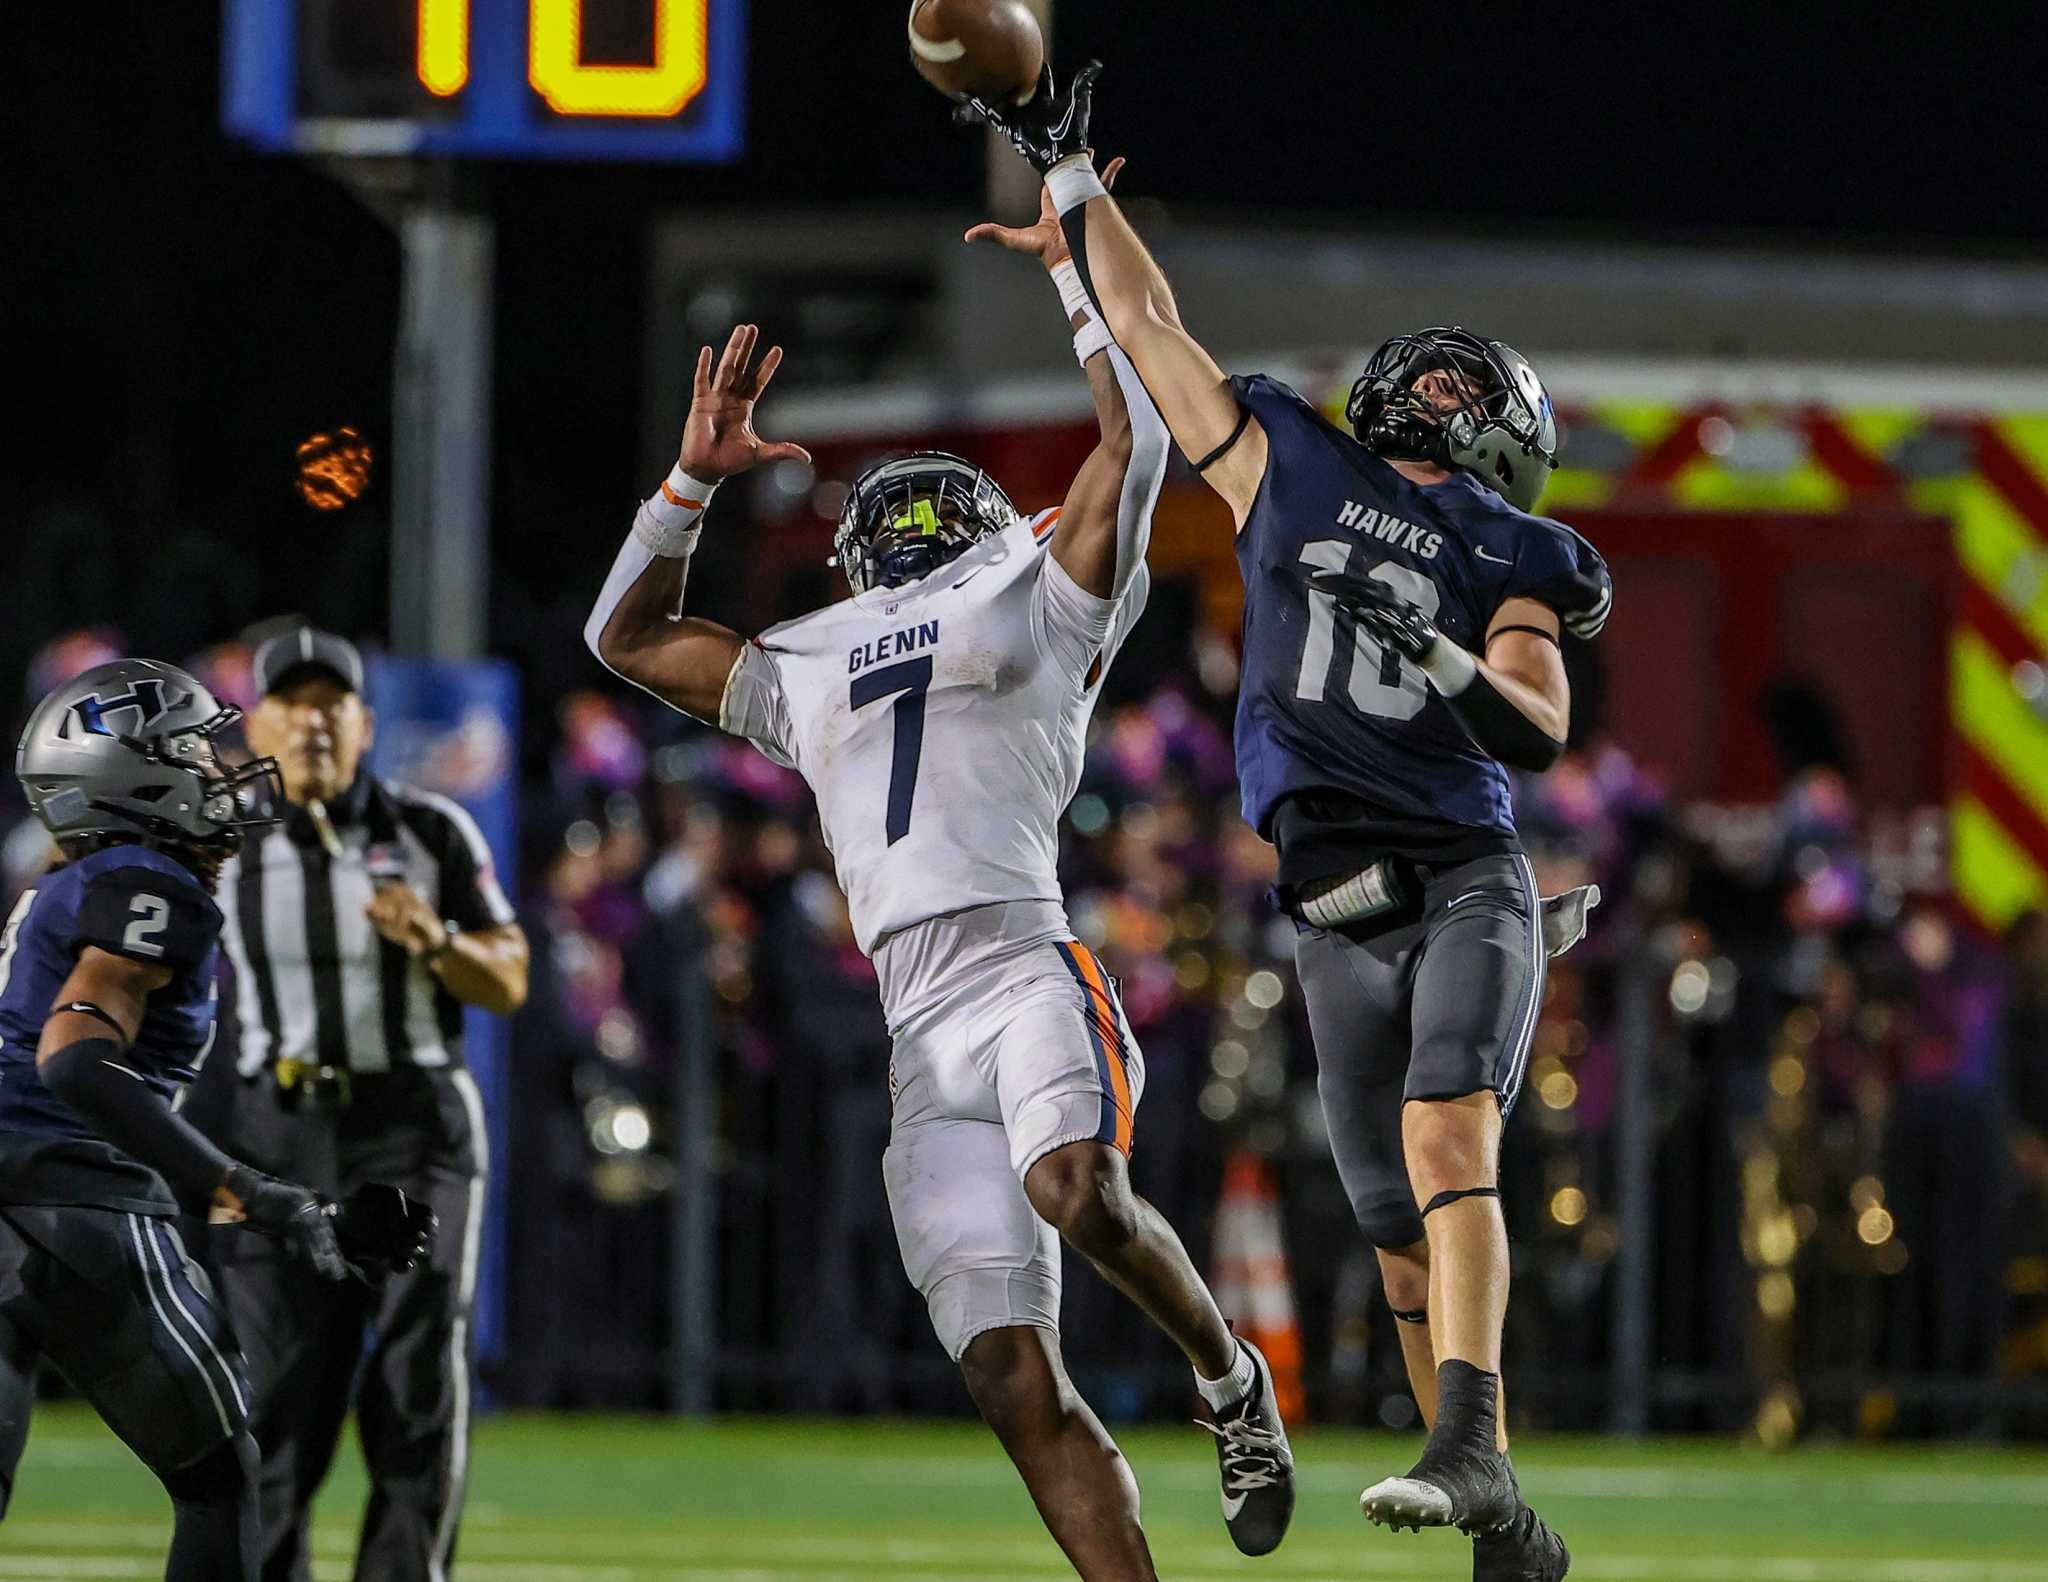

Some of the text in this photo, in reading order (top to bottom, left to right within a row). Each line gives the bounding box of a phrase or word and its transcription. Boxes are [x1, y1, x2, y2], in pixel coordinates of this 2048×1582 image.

[1336, 500, 1445, 560] HAWKS
[848, 619, 940, 674] GLENN
[849, 654, 933, 848] 7
[122, 892, 171, 958] 2
